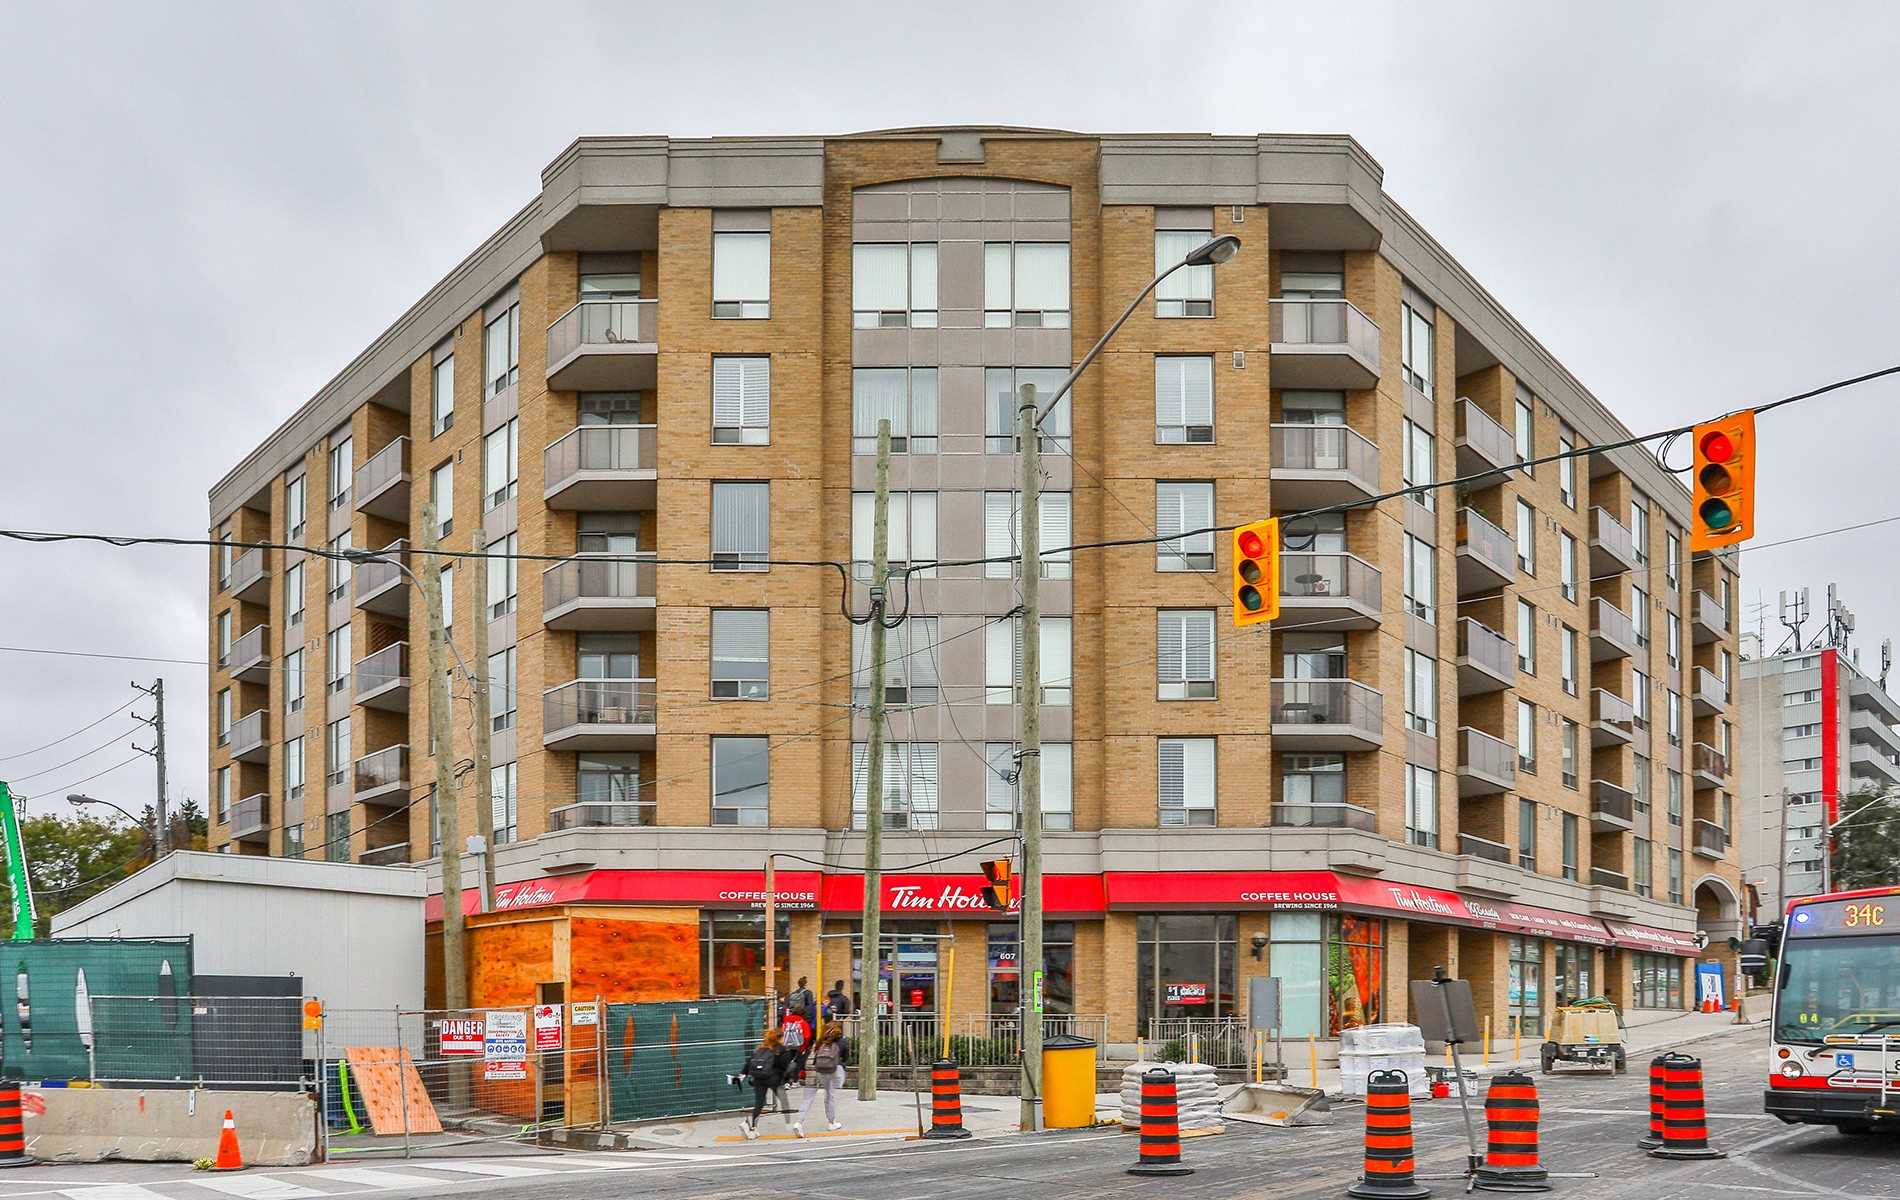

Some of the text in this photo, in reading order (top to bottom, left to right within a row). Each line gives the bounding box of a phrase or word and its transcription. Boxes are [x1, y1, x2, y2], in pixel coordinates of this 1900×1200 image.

[719, 891, 815, 900] COFFEE HOUSE
[890, 886, 934, 909] Tim
[1240, 892, 1337, 901] COFFEE HOUSE
[1845, 903, 1885, 927] 34C
[999, 952, 1016, 961] 607
[442, 1020, 483, 1035] DANGER
